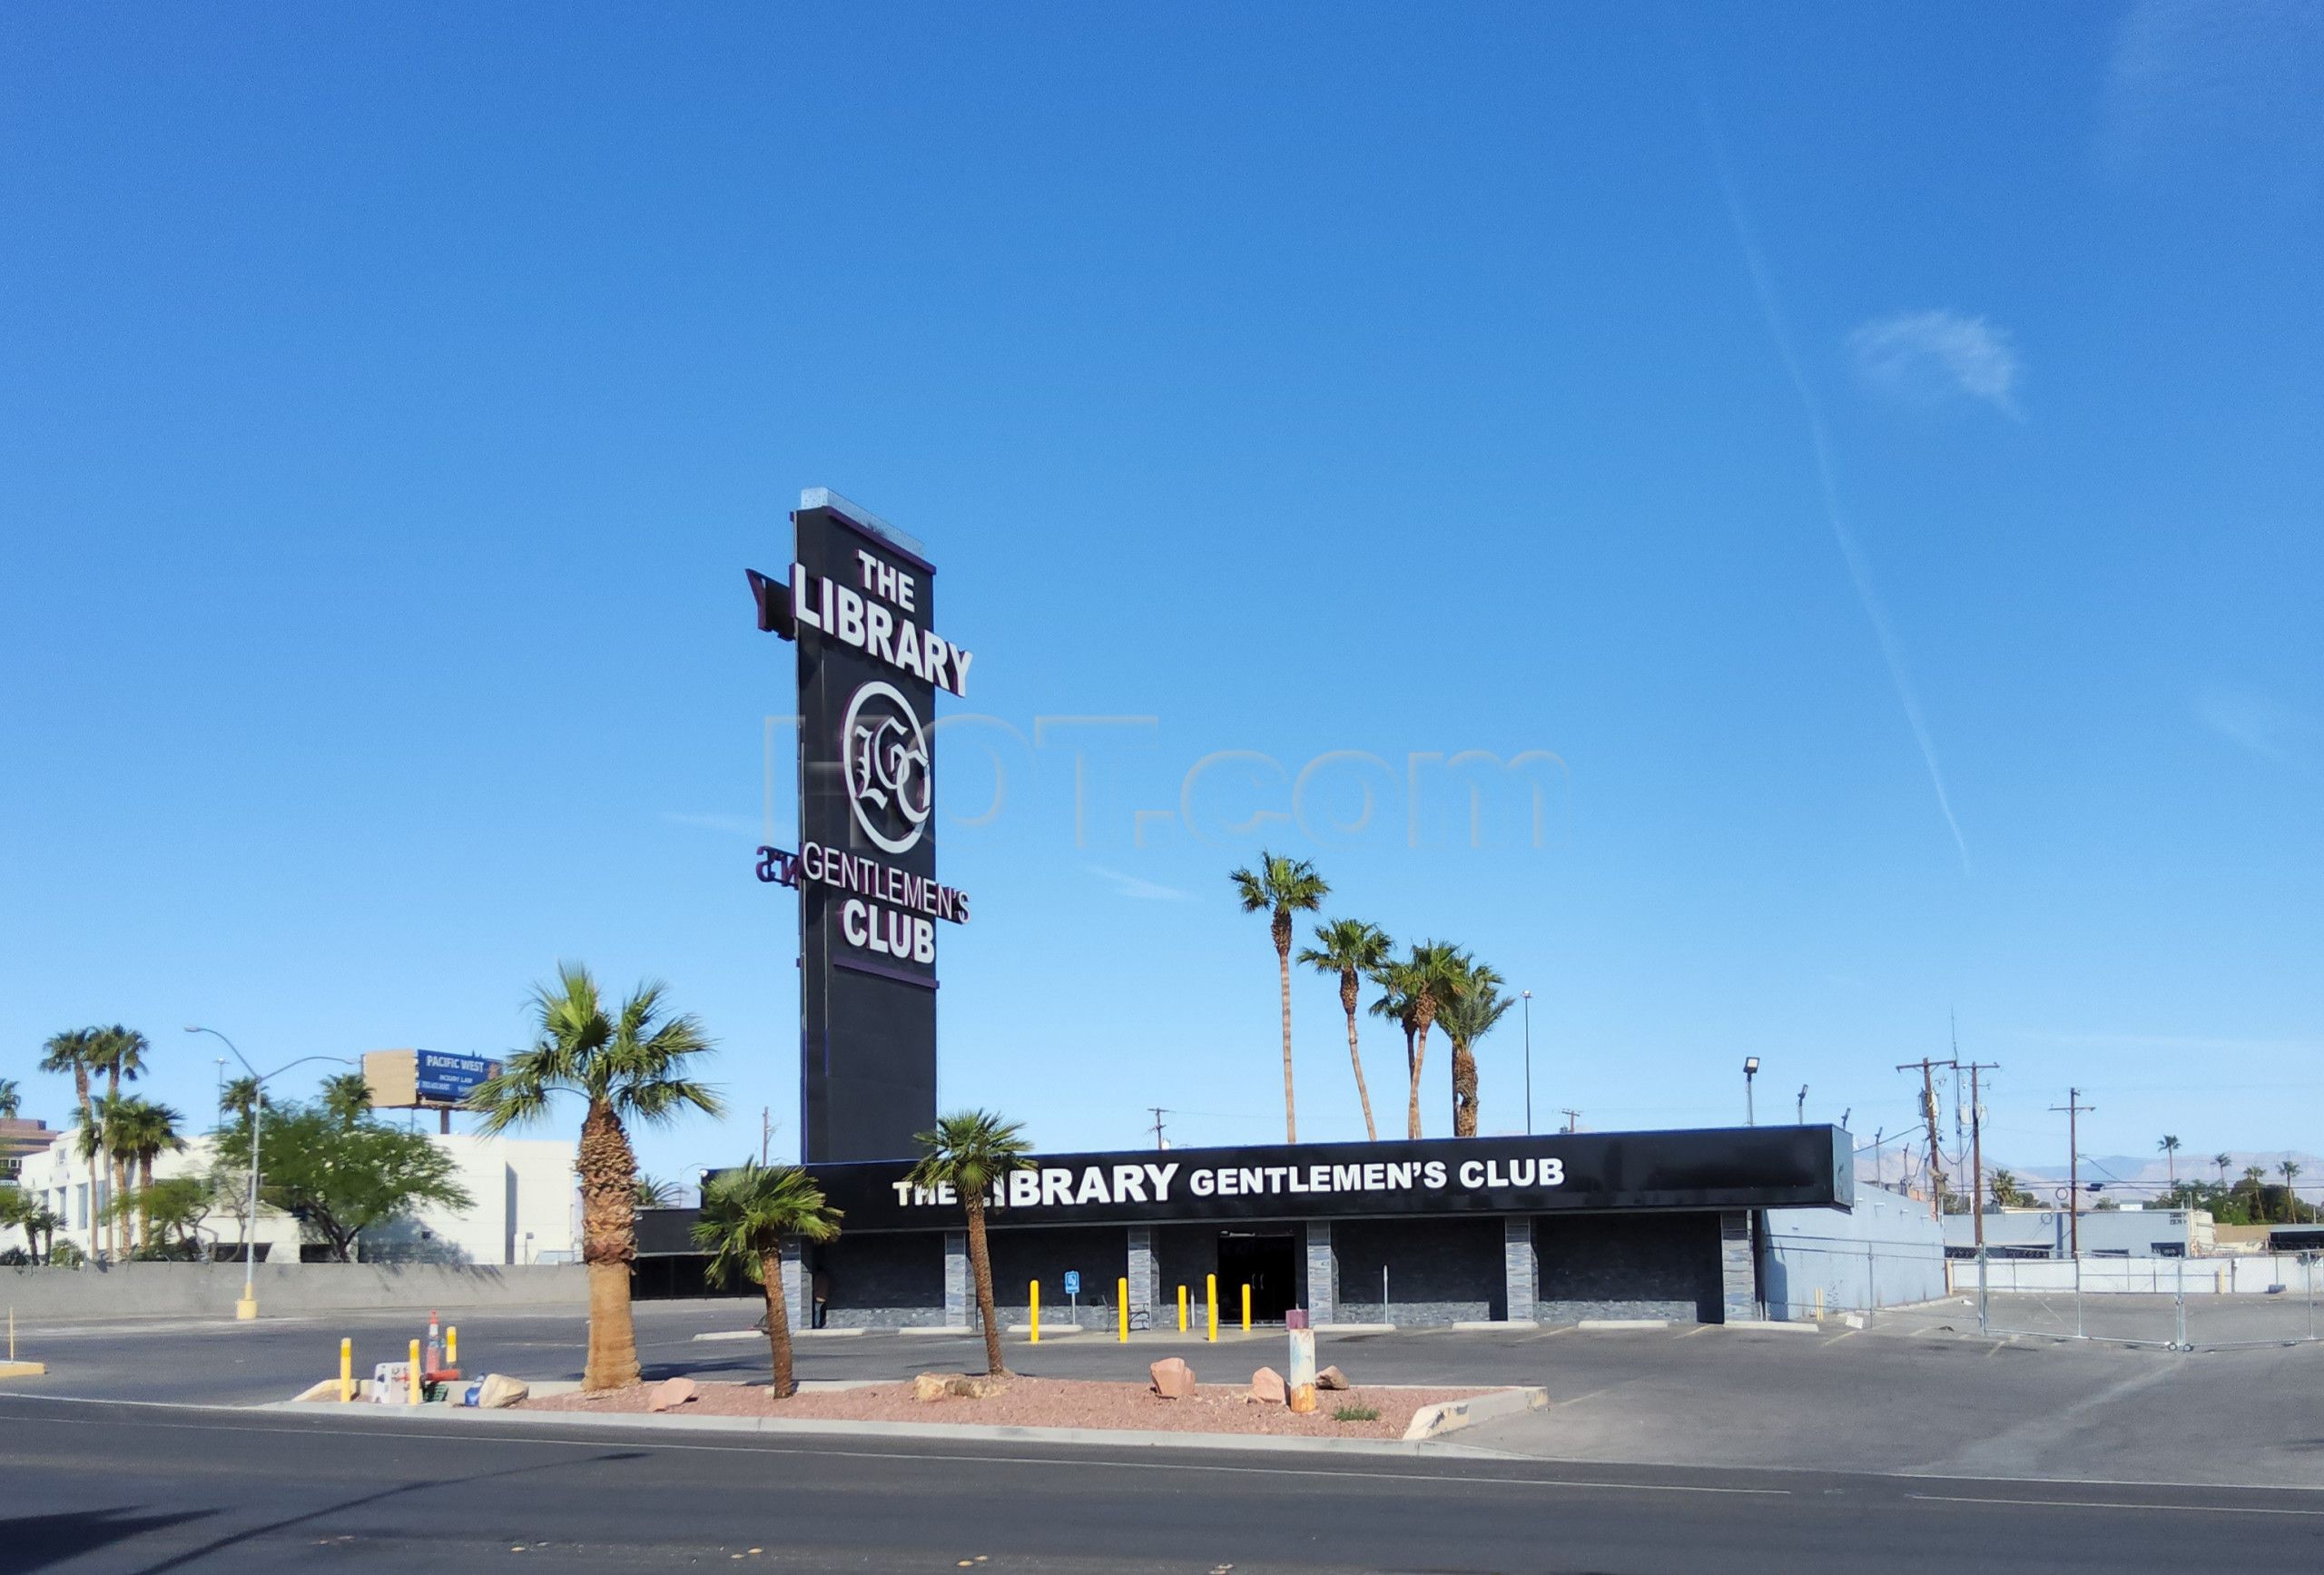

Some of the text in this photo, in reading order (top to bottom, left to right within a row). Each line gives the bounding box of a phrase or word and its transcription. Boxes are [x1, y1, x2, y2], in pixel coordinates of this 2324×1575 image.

[857, 548, 915, 613] THE
[790, 562, 973, 697] LIBRARY
[802, 842, 970, 924] GENTLEMEN'S
[842, 899, 935, 964] CLUB
[426, 1055, 484, 1073] PACIFIC WEST
[892, 1157, 1565, 1207] THE IBRARY GENTLEMEN'S CLUB
